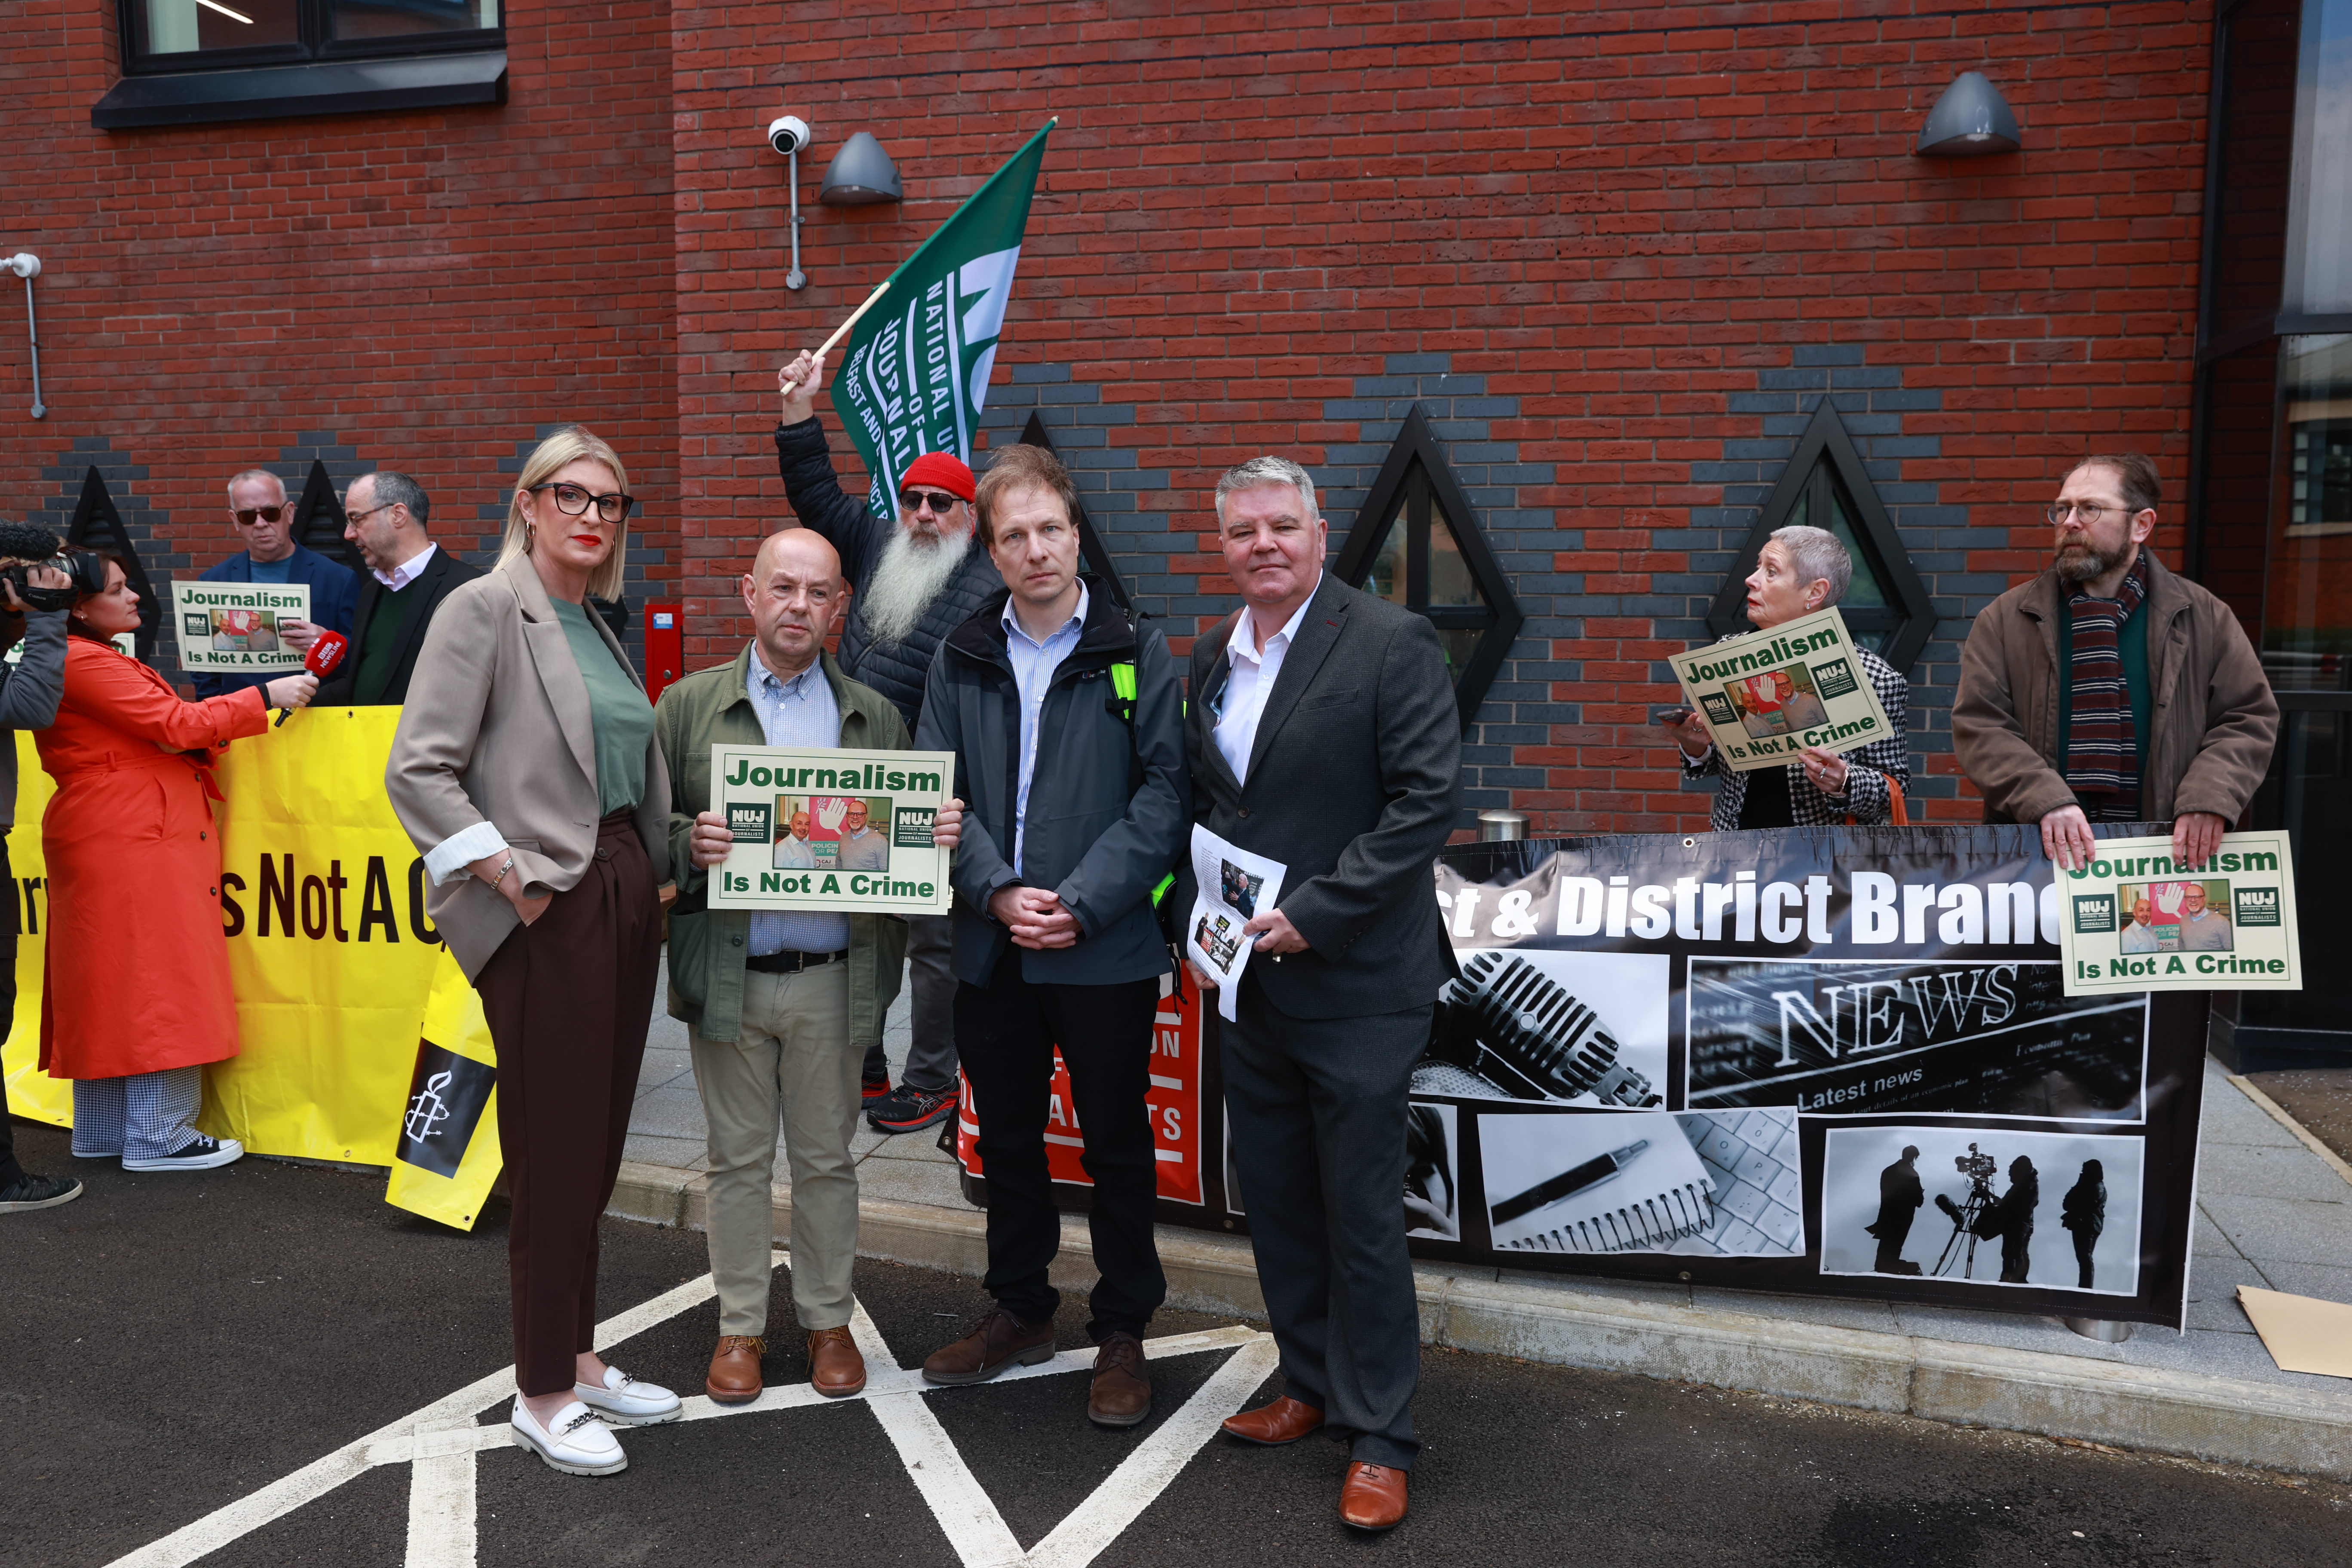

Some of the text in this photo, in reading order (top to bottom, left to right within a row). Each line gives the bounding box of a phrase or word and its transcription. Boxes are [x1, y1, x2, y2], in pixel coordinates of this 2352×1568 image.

[925, 279, 950, 420] NATIONAL
[846, 343, 867, 407] BELFAST
[860, 406, 882, 443] AND
[909, 396, 925, 426] OF
[181, 589, 302, 607] Journalism
[188, 651, 306, 664] Is Not A Crime
[317, 642, 334, 660] BBC
[320, 641, 342, 668] NEWSLINE
[1687, 628, 1839, 684] Journalism
[1816, 662, 1847, 681] NUJ
[1704, 698, 1726, 710] NUJ
[1726, 717, 1876, 760] Is Not A Crime
[725, 760, 940, 792] Journalism
[732, 810, 765, 823] NUJ
[899, 812, 933, 826] NUJ
[724, 872, 934, 897] Is Not A Crime
[257, 853, 348, 943] Not
[358, 856, 400, 943] A
[1491, 889, 1539, 937] &
[1556, 870, 1832, 944] District
[2079, 900, 2110, 913] NUJ
[2239, 891, 2275, 905] NUJ
[2077, 960, 2101, 979] Is
[2110, 957, 2156, 977] Not
[2165, 956, 2187, 974] A
[2196, 955, 2285, 975] Crime
[1771, 964, 2020, 1068] NEWS
[1798, 1068, 1923, 1112] Latest news
